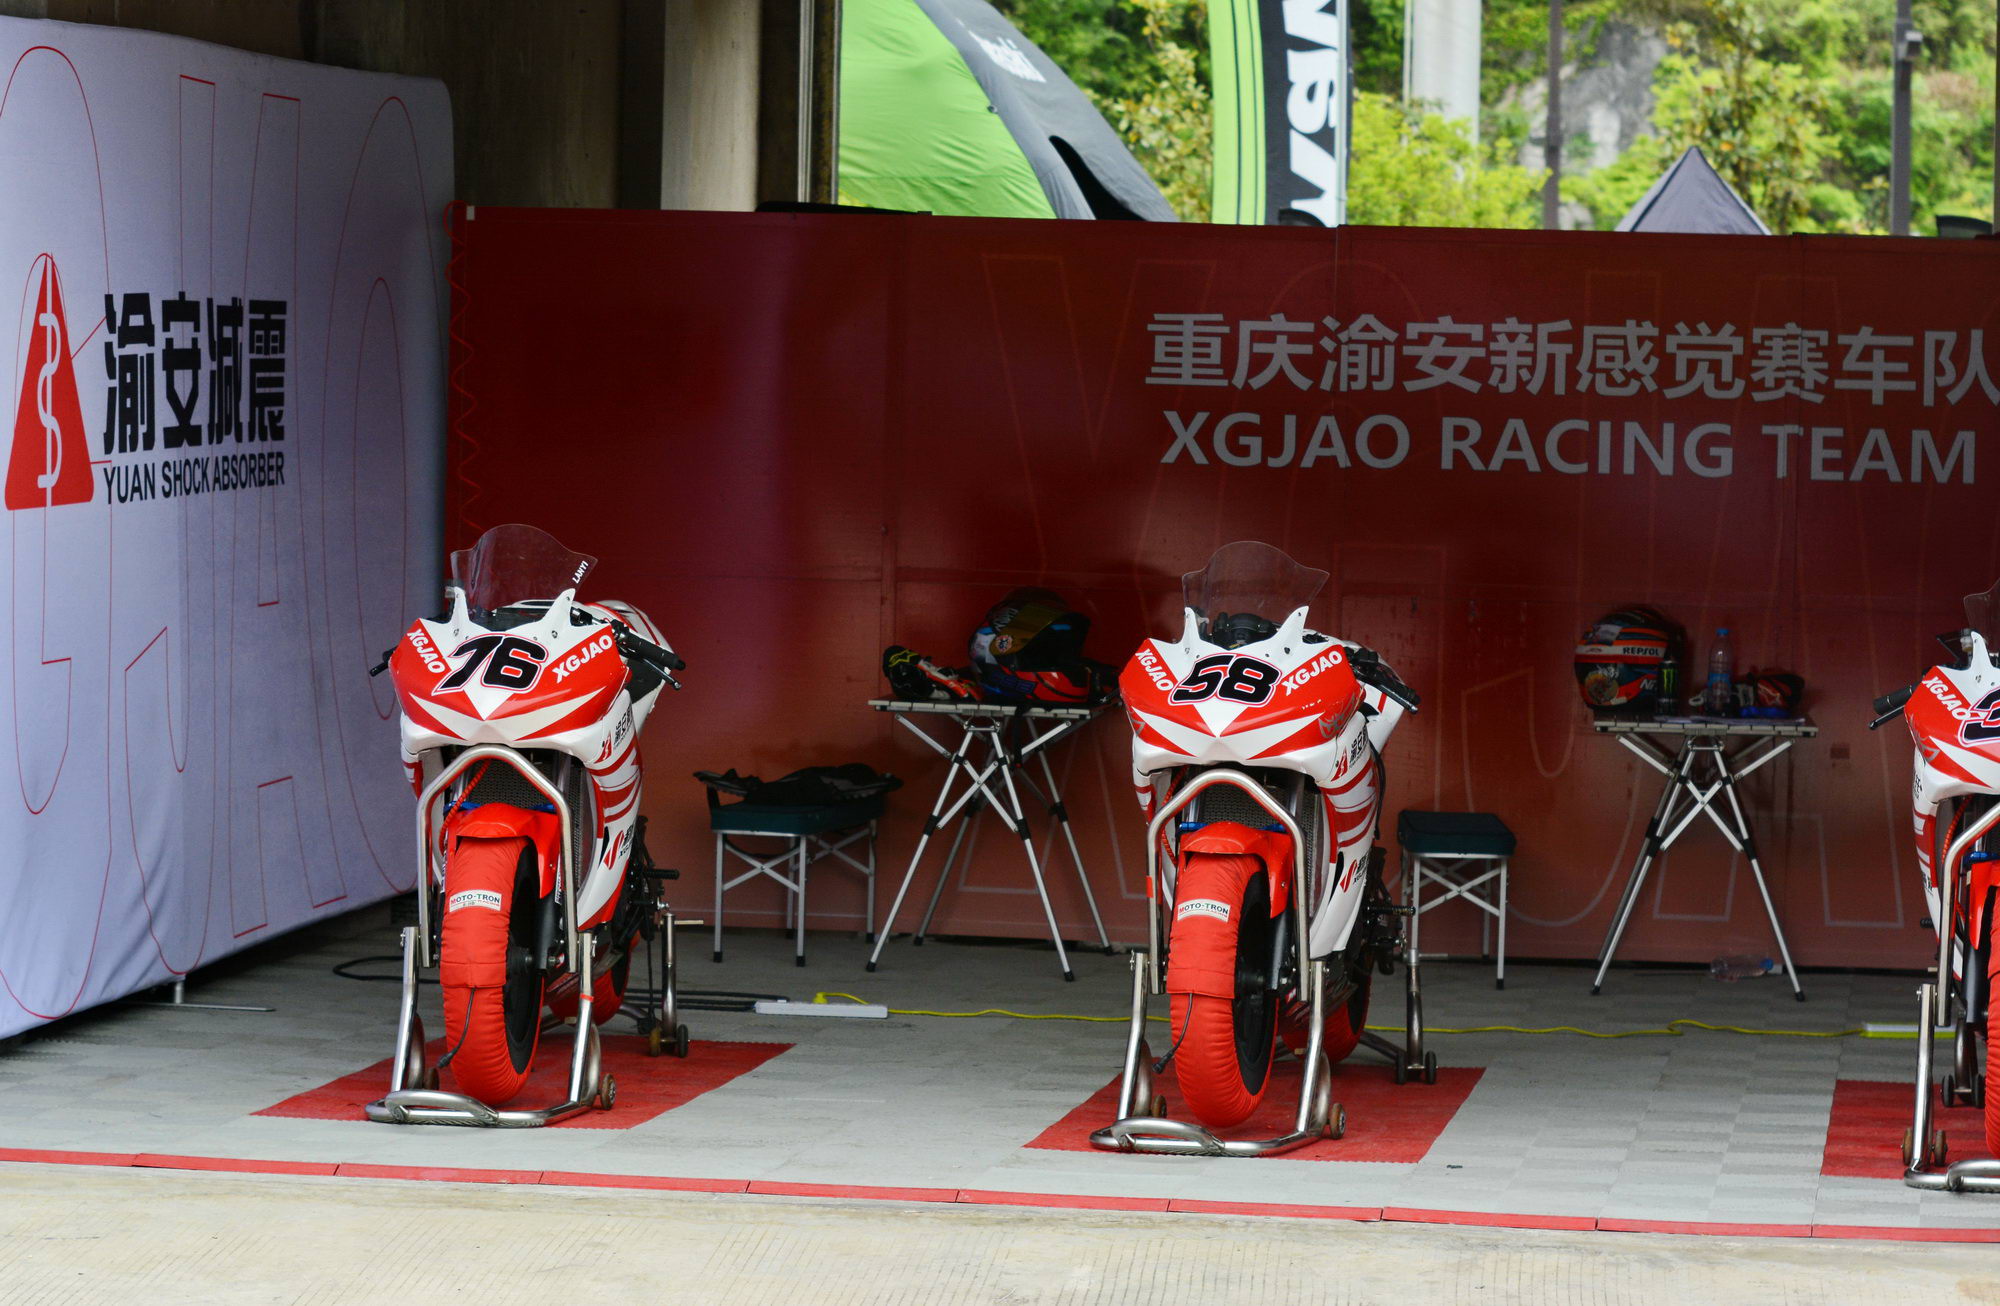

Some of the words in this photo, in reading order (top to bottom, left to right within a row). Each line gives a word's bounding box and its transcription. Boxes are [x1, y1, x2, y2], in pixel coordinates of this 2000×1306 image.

[1145, 313, 1999, 406] 重庆渝安新感觉赛车队
[1162, 411, 1410, 470] XGJAO
[1441, 417, 1733, 478] RACING
[1762, 424, 1975, 484] TEAM
[103, 463, 156, 504] YUAN
[162, 457, 210, 499] SHOCK
[212, 451, 286, 491] ABSORBER
[572, 560, 589, 584] LANYI
[407, 628, 446, 674] XGJAO
[436, 633, 549, 693] 76
[552, 634, 613, 683] XGJAO
[1135, 648, 1174, 692] XGJAO
[1281, 650, 1343, 697] XGJAO
[1622, 646, 1660, 657] REPSOL
[1170, 653, 1281, 705] 58
[1922, 676, 1971, 721] XGJAO
[450, 892, 501, 905] MOTO-TRON
[1179, 902, 1229, 915] MOTO-TRON
